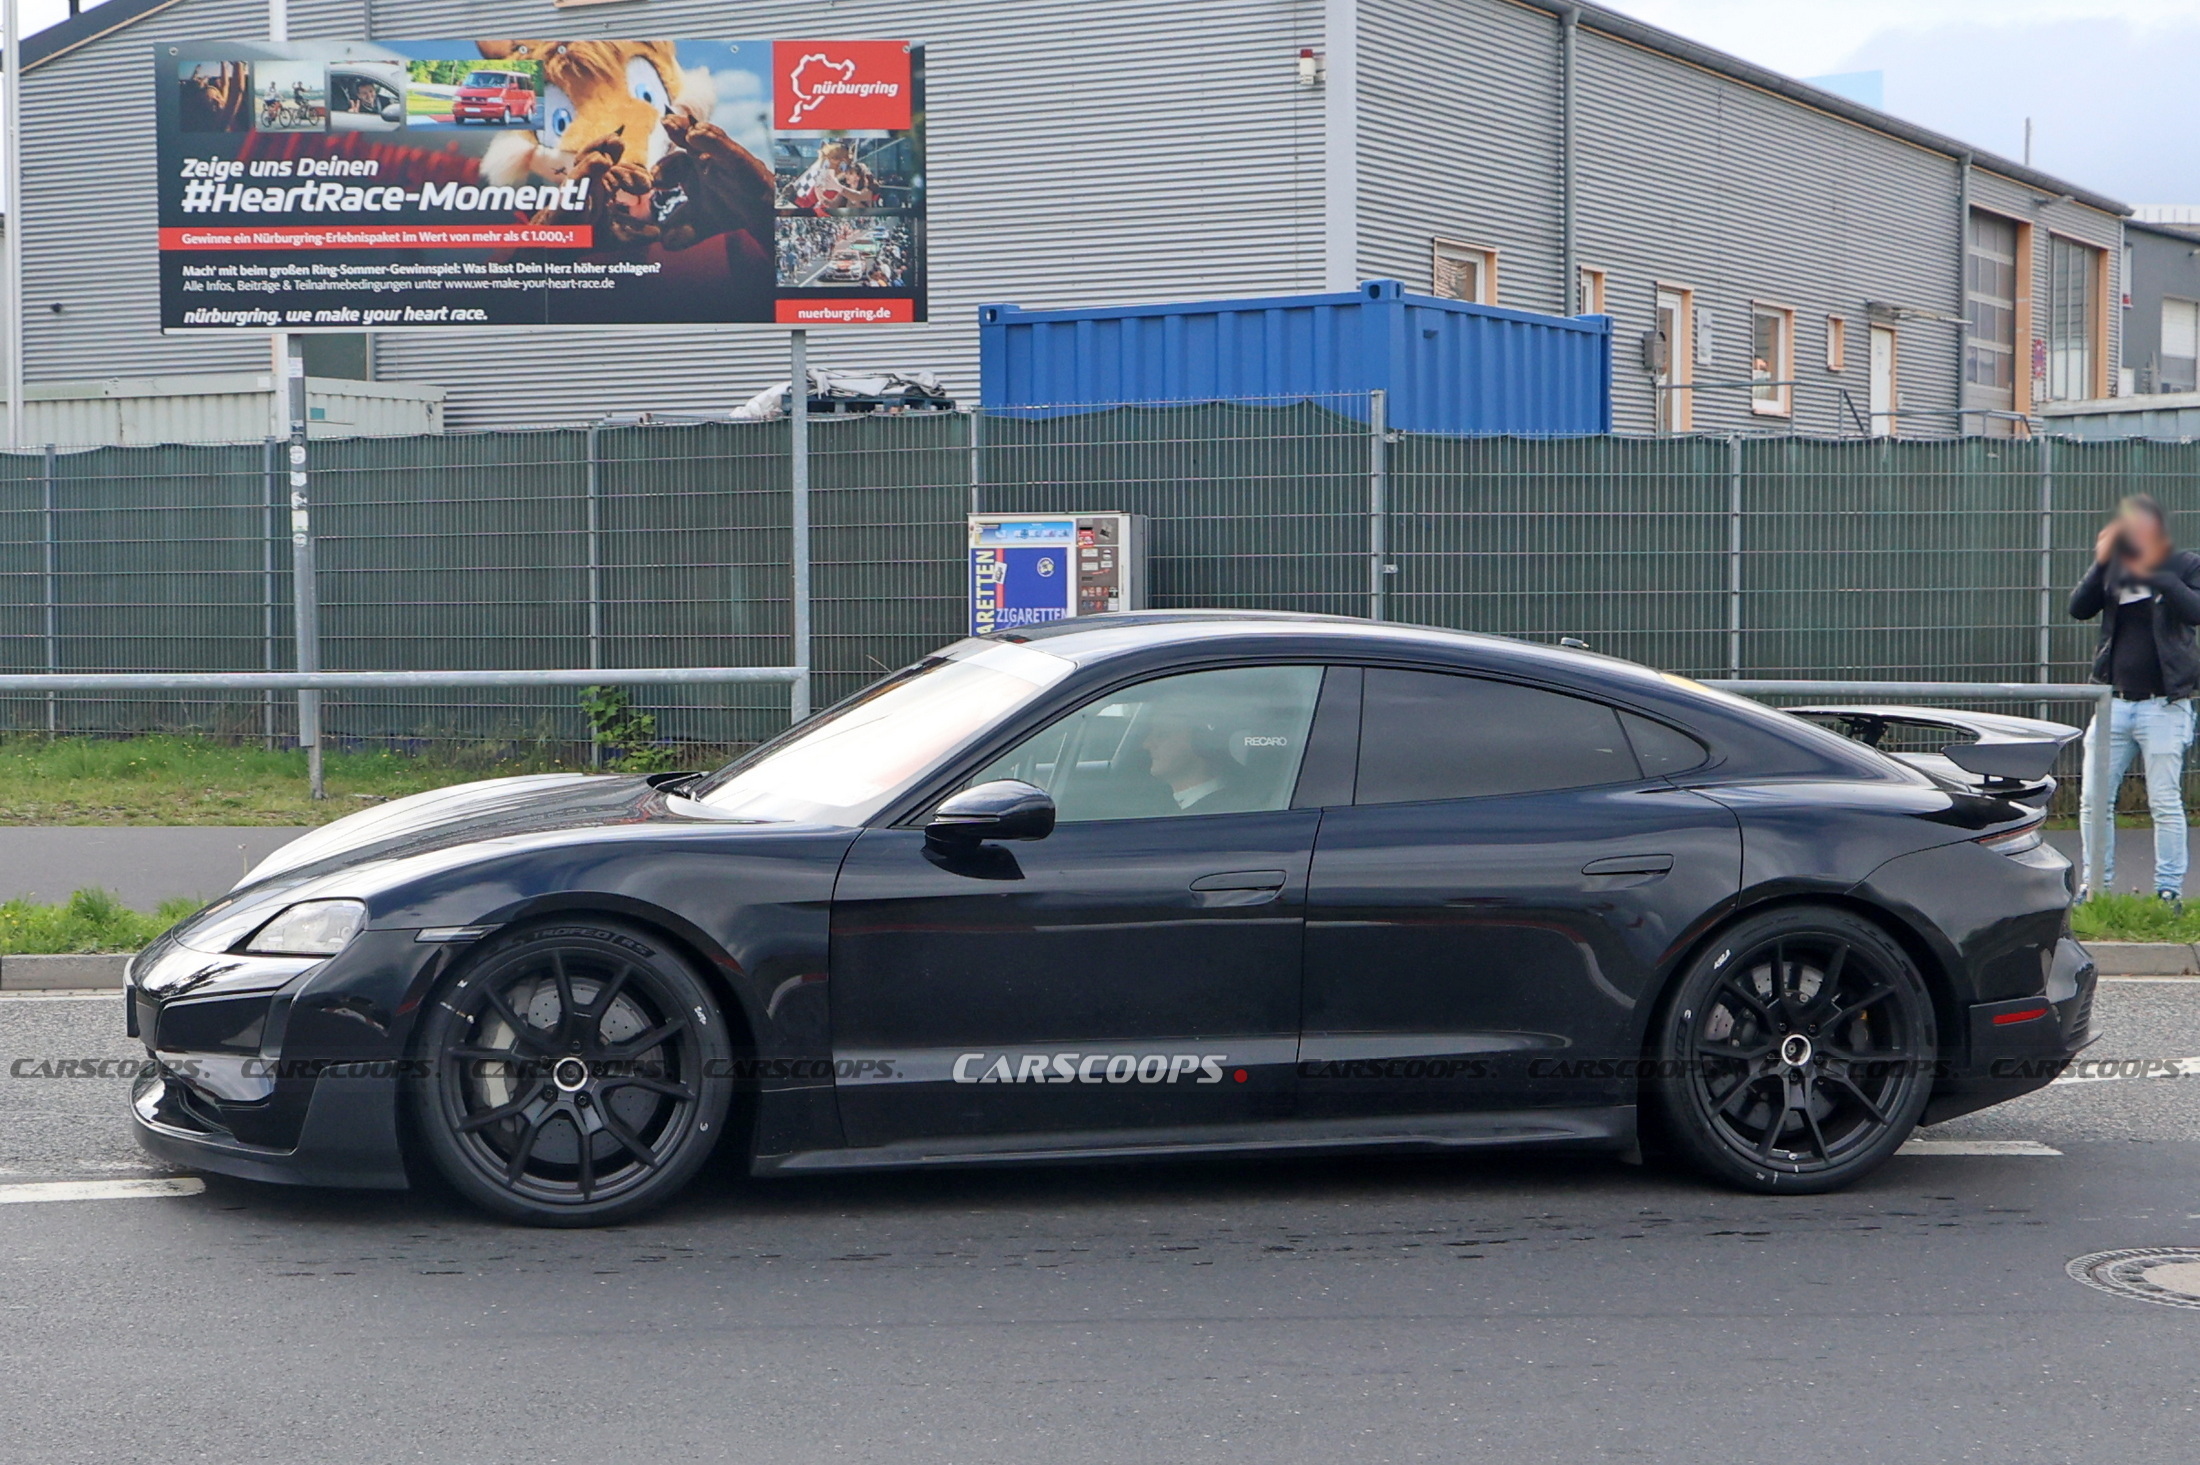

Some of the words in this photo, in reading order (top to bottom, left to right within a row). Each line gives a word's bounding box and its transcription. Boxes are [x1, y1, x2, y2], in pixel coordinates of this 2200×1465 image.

[812, 81, 898, 99] nürburgring
[180, 156, 244, 182] Zeige
[249, 159, 293, 177] uns
[297, 155, 380, 177] Deinen
[181, 177, 591, 213] #HeartRace-Moment!
[181, 233, 232, 245] Gewinne
[233, 233, 251, 244] ein
[253, 231, 400, 246] Nürburgring-Erlebnispaket
[402, 231, 417, 242] im
[419, 231, 448, 242] Wert
[449, 233, 470, 242] von
[472, 230, 502, 242] mehr
[503, 230, 519, 241] als
[520, 231, 530, 241] €
[531, 230, 574, 243] 1.000,-!
[218, 264, 238, 276] mit
[239, 264, 268, 276] beim
[269, 264, 310, 278] großen
[311, 262, 461, 277] Ring-Sommer-Gewinnspiel:
[462, 263, 487, 274] Was
[488, 262, 514, 274] lässt
[516, 262, 543, 273] Dein
[544, 262, 571, 274] Herz
[573, 261, 607, 273] höher
[608, 261, 661, 276] schlagen?
[183, 280, 204, 291] Alle
[206, 279, 235, 292] Infos,
[236, 279, 281, 293] Beiträge
[282, 280, 292, 290] &
[294, 279, 412, 293] Teilnahmebedingungen
[414, 279, 442, 289] unter
[444, 277, 616, 291] www.we-make-your-heart-race.de
[183, 307, 282, 326] nürburgring.
[285, 310, 313, 322] we
[314, 306, 360, 322] make
[362, 308, 402, 325] your
[403, 305, 449, 321] heart
[450, 308, 488, 320] race.
[798, 308, 891, 321] nuerburgring.de
[1244, 736, 1287, 746] RECARO
